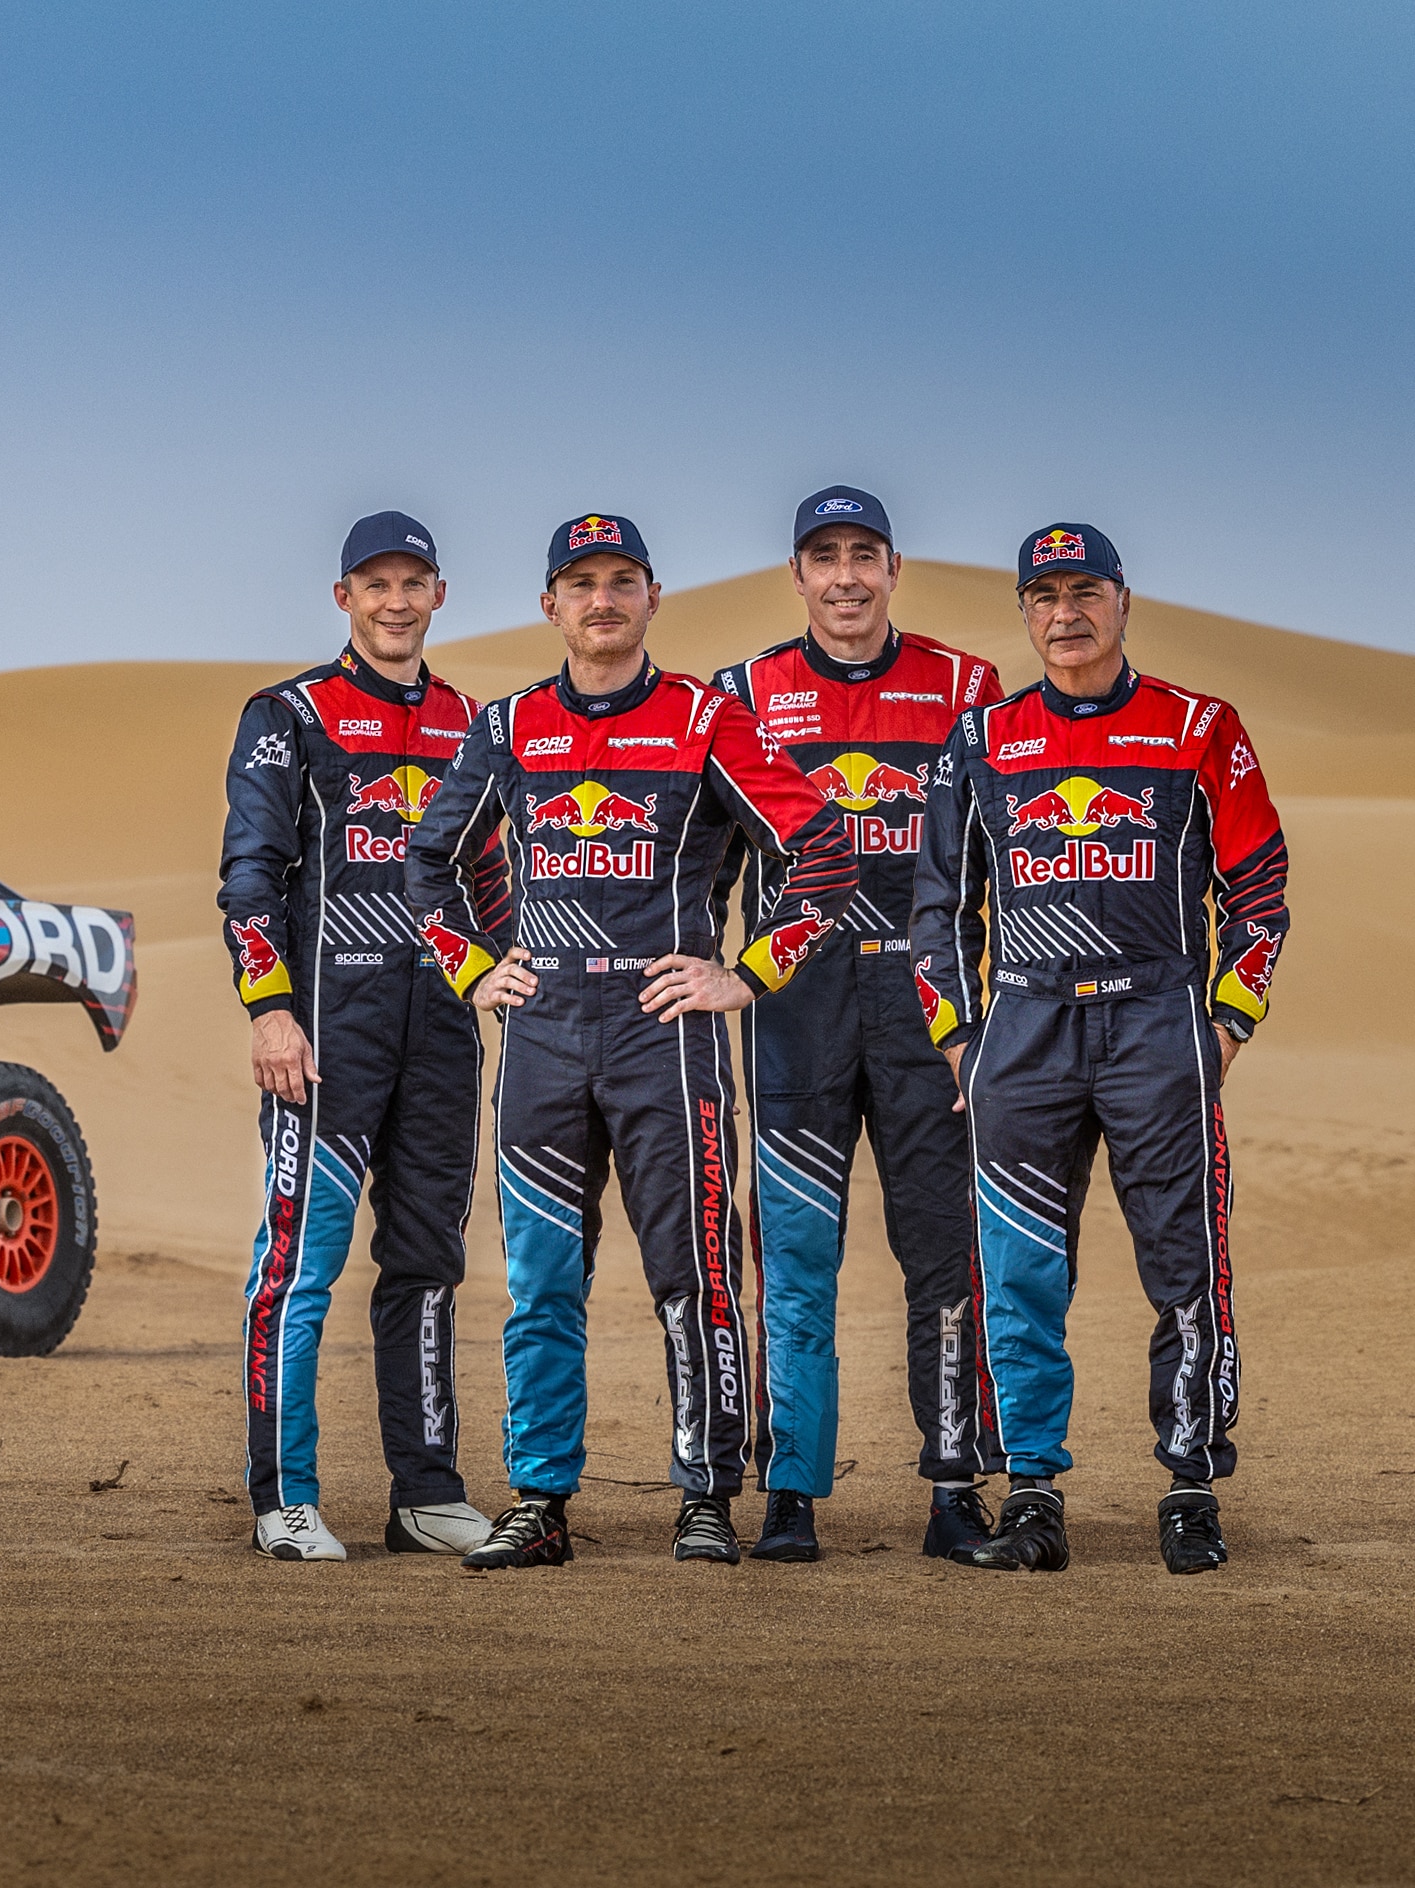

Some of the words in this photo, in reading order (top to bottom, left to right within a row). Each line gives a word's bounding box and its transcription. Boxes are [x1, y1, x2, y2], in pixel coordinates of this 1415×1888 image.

[823, 500, 853, 512] Ford
[405, 534, 429, 549] FORD
[768, 691, 818, 707] FORD
[879, 691, 947, 706] RAPTOR
[964, 665, 984, 704] sparco
[279, 690, 314, 725] sparco
[488, 704, 505, 745] sparco
[695, 696, 726, 735] sparco
[767, 702, 817, 712] PERFORMANCE
[768, 716, 804, 727] SAMSUNG
[806, 714, 821, 722] SSD
[1193, 702, 1221, 737] sparco
[339, 720, 382, 730] FORD
[961, 711, 978, 746] sparco
[1107, 735, 1178, 750] RAPTOR
[522, 747, 571, 757] PERFORMANCE
[525, 735, 573, 751] FORD
[607, 737, 678, 750] RAPTOR
[999, 737, 1047, 755] FORD
[335, 953, 383, 965] sparco
[995, 969, 1029, 987] sparco
[1101, 978, 1132, 993] SAINZ
[276, 1108, 300, 1197] FORD
[699, 1099, 731, 1327] PERFORMANCE
[1213, 1102, 1233, 1334] PERFORMANCE
[248, 1194, 294, 1412] PERFORMANCE
[420, 1285, 448, 1446] RAPTOR
[665, 1296, 700, 1460] RAPTOR
[714, 1327, 739, 1415] FORD
[939, 1296, 971, 1460] RAPTOR
[1168, 1296, 1202, 1457] RAPTOR
[1217, 1335, 1236, 1418] FORD
